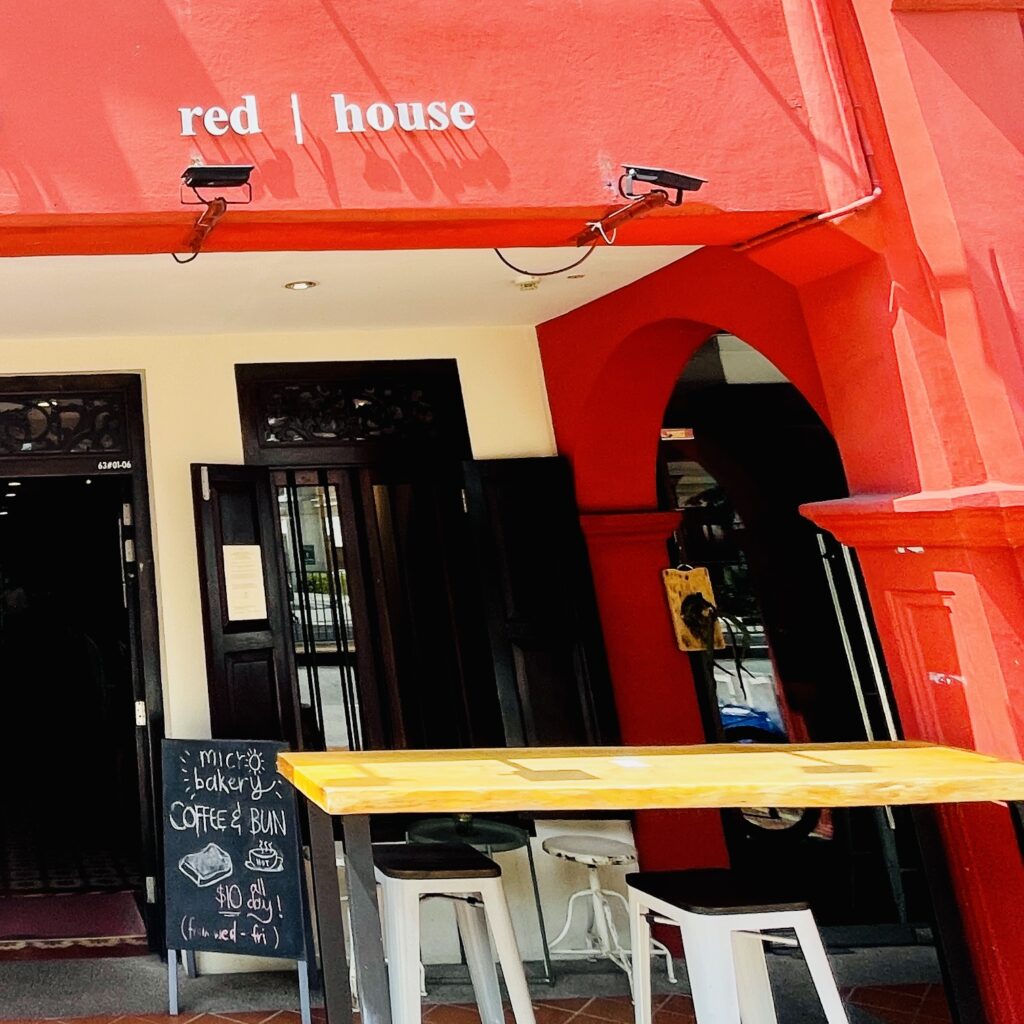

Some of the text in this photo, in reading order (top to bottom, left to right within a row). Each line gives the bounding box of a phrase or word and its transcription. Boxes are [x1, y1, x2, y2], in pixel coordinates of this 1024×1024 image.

[178, 94, 262, 136] red
[331, 93, 476, 134] house
[199, 749, 263, 773] micro
[194, 767, 277, 801] bakery
[169, 801, 287, 838] COFFEE & BUN
[215, 883, 243, 910] $10
[249, 877, 266, 897] all
